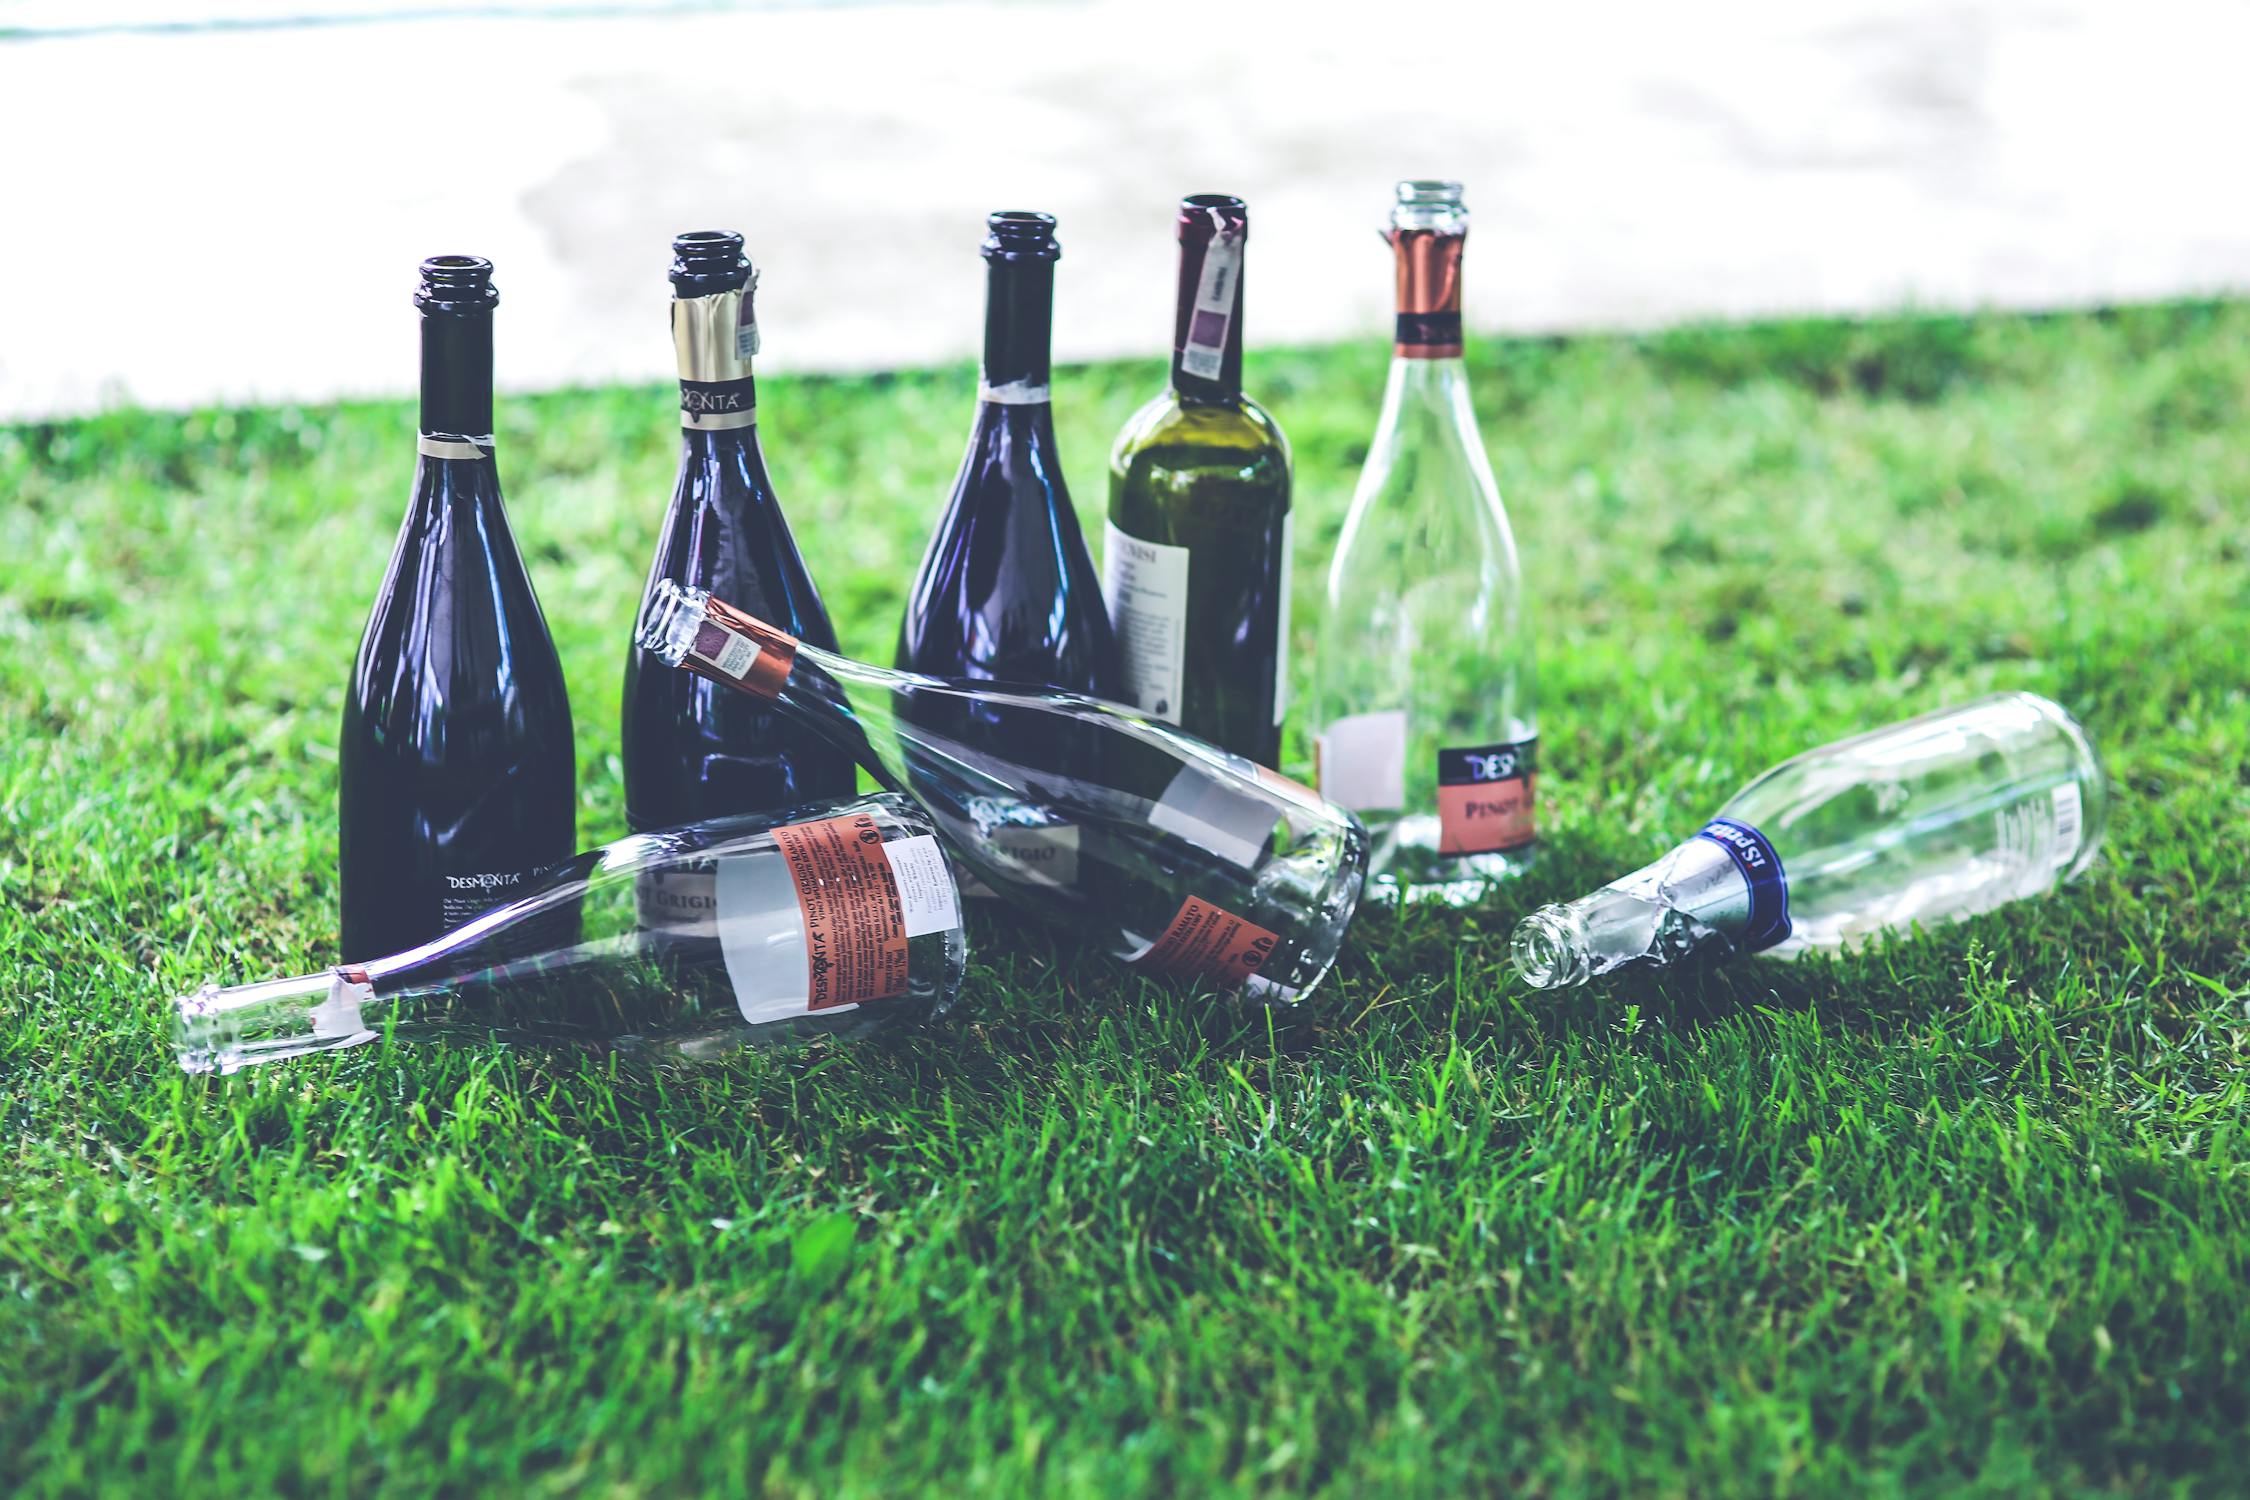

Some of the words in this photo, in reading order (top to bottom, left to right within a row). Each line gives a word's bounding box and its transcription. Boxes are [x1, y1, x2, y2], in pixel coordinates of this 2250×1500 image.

[779, 830, 803, 863] RAMATO
[794, 862, 814, 896] GRIGIO
[804, 895, 821, 929] PINOT
